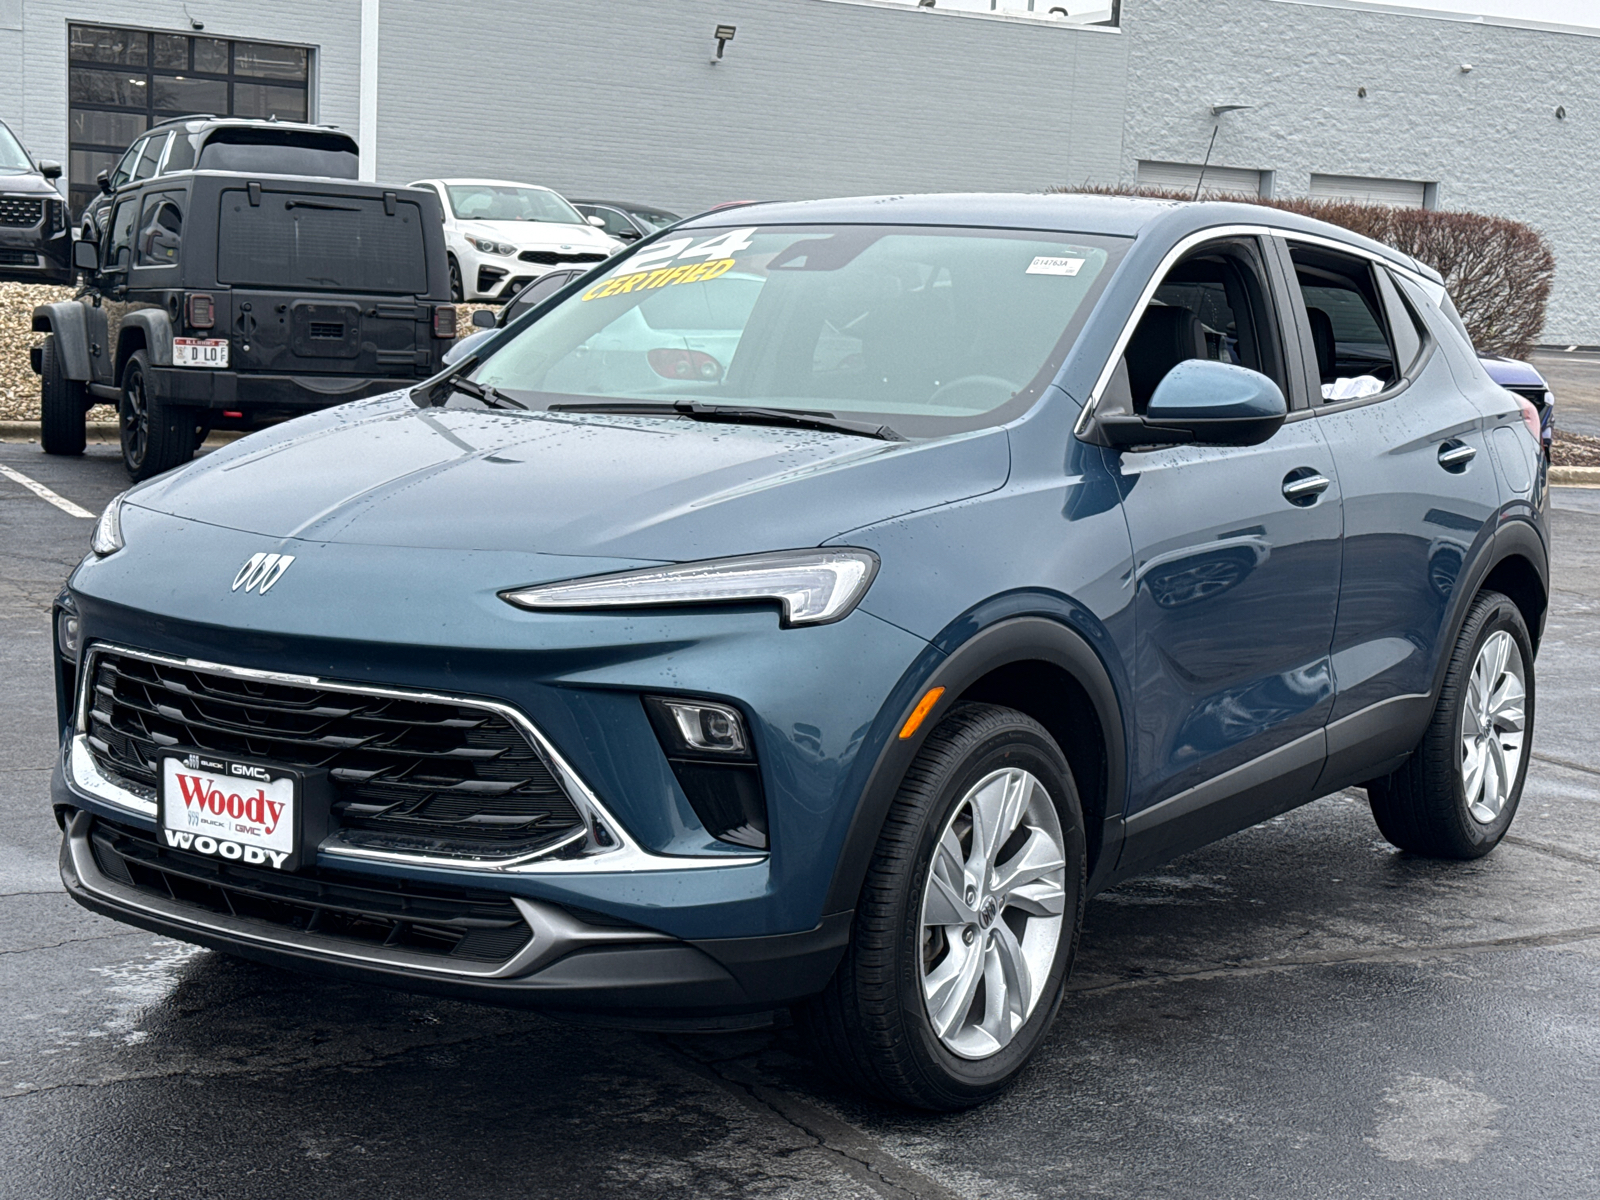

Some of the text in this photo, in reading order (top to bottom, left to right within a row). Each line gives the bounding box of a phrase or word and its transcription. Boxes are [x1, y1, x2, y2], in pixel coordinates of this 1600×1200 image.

[611, 227, 758, 278] 24
[1033, 259, 1068, 267] G14763A
[581, 258, 736, 302] CERTIFIED
[191, 347, 198, 360] D
[201, 760, 265, 778] BUICK GMC
[175, 773, 286, 835] Woody
[201, 818, 261, 837] BUICK GMC
[164, 829, 289, 869] WOODY
